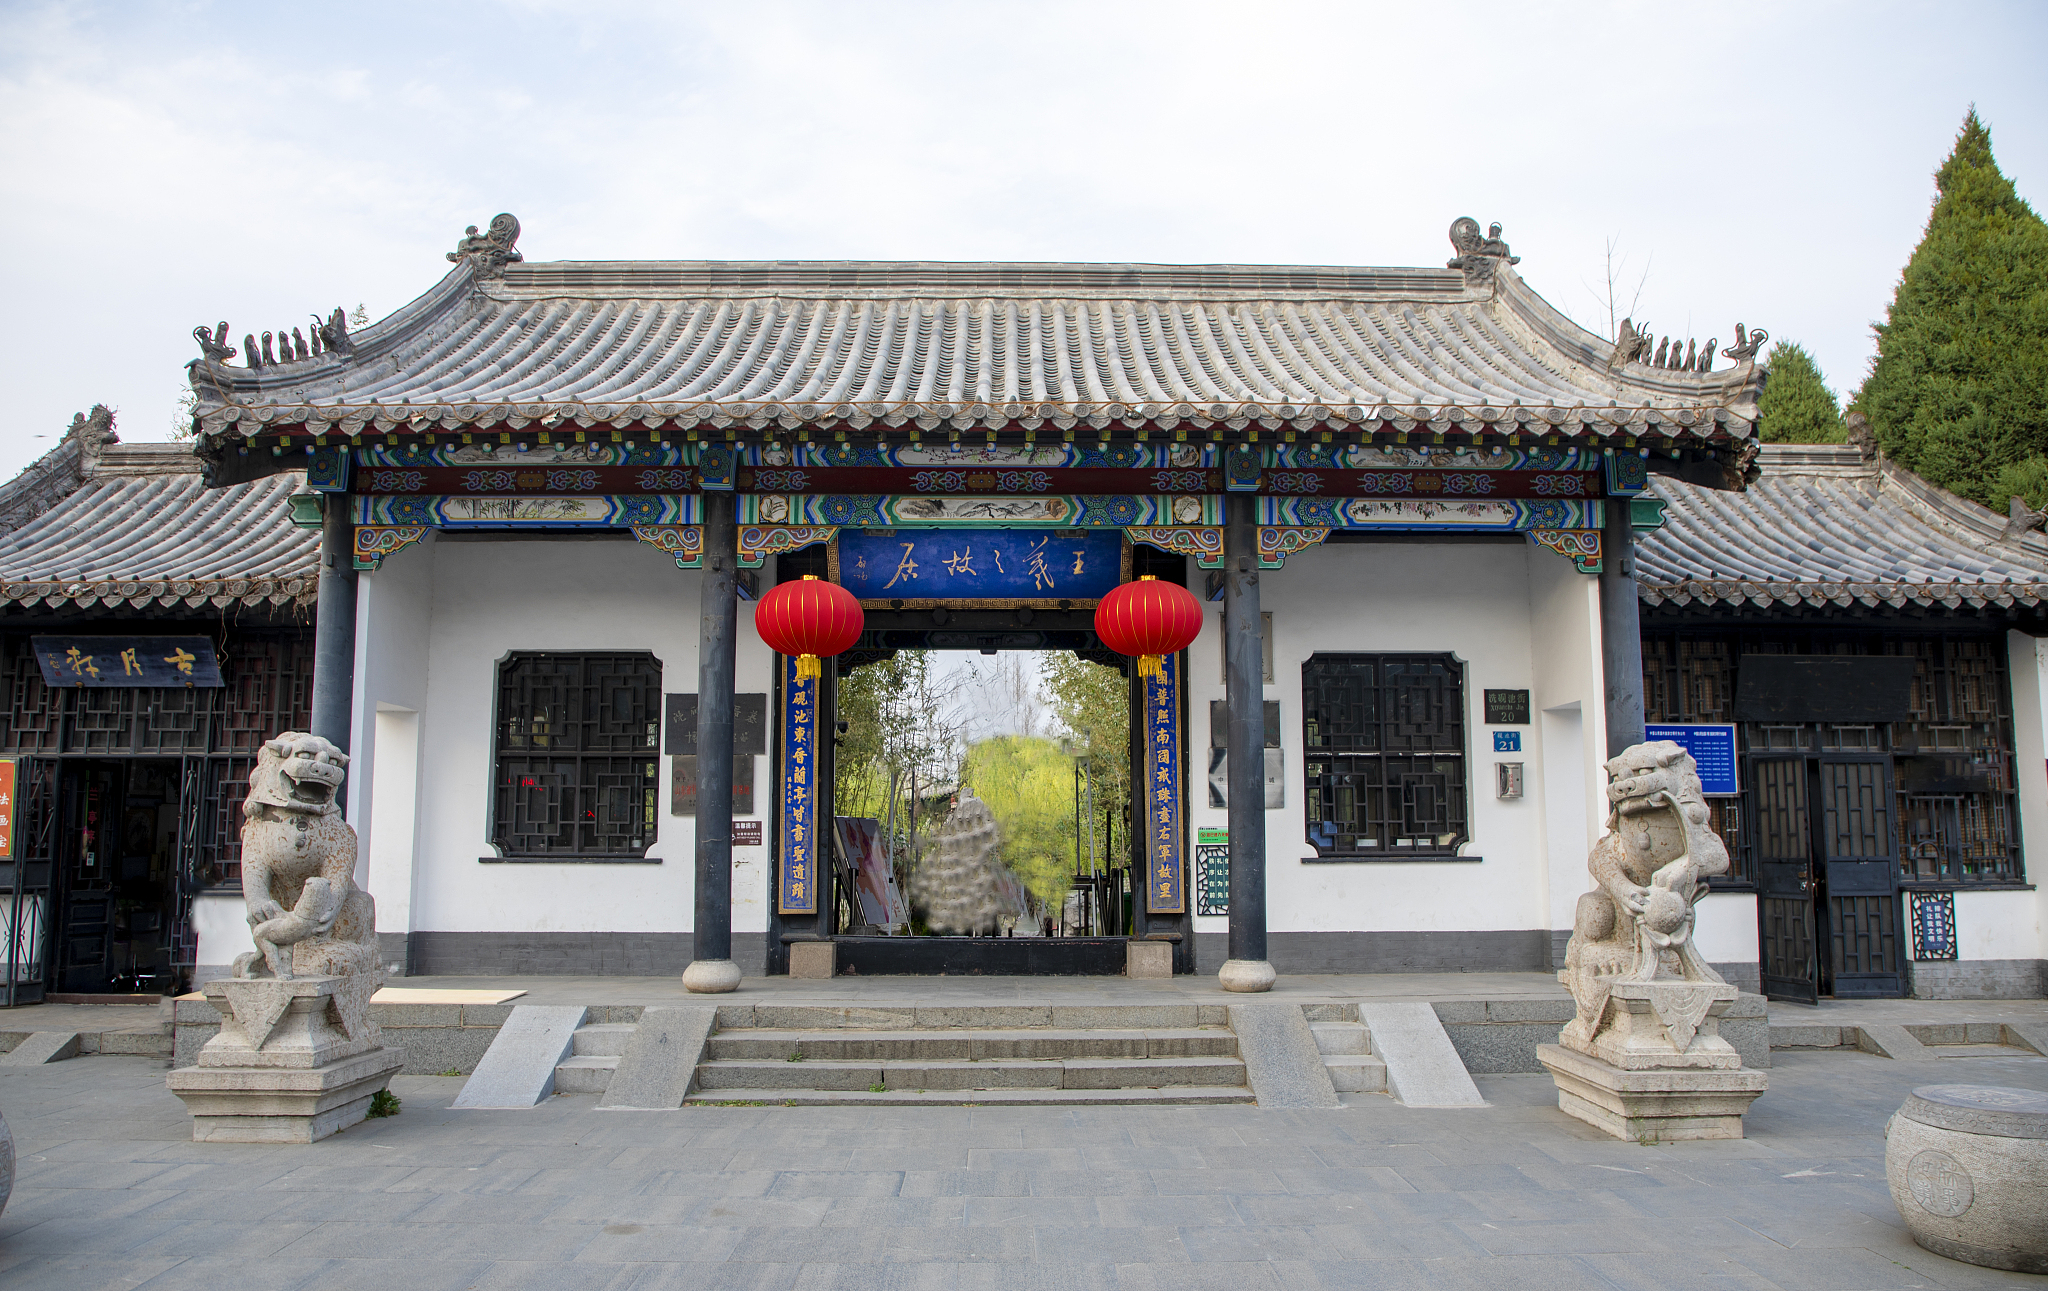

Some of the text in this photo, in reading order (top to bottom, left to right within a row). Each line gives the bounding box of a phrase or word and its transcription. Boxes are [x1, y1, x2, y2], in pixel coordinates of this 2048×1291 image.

[883, 535, 1085, 590] 王羲之故居
[1501, 711, 1515, 722] 20
[1499, 740, 1516, 751] 21
